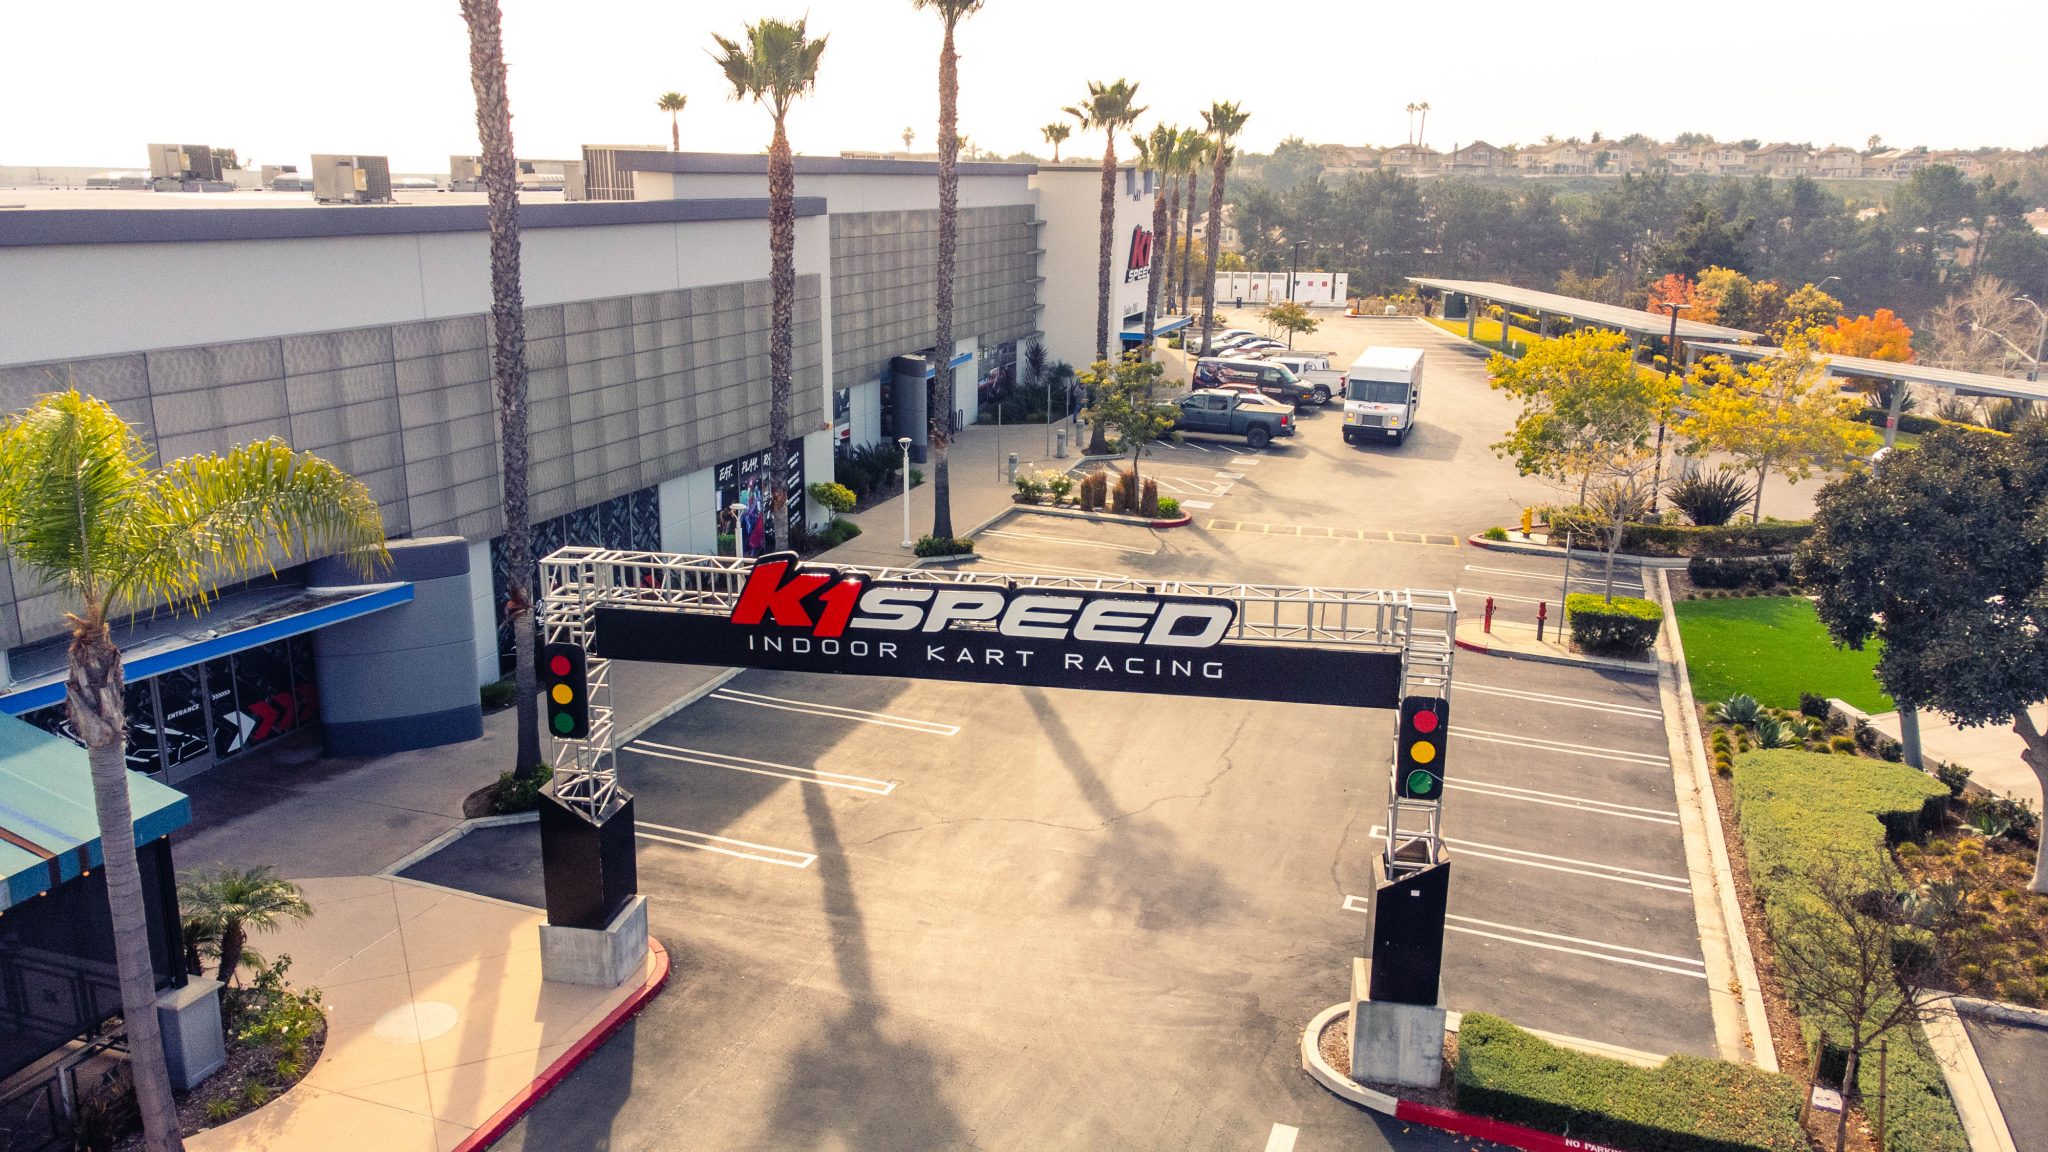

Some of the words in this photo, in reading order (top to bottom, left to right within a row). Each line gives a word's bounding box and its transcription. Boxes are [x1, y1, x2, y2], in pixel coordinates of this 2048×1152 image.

[1128, 267, 1151, 282] SPEE
[719, 464, 733, 481] EAT.
[741, 457, 758, 474] PLAY.
[850, 587, 1232, 648] SPEED
[749, 634, 897, 659] INDOOR
[927, 645, 1034, 667] KART
[1064, 653, 1223, 679] RACING
[167, 703, 200, 720] ENTRANCE
[1565, 1138, 1581, 1148] NO
